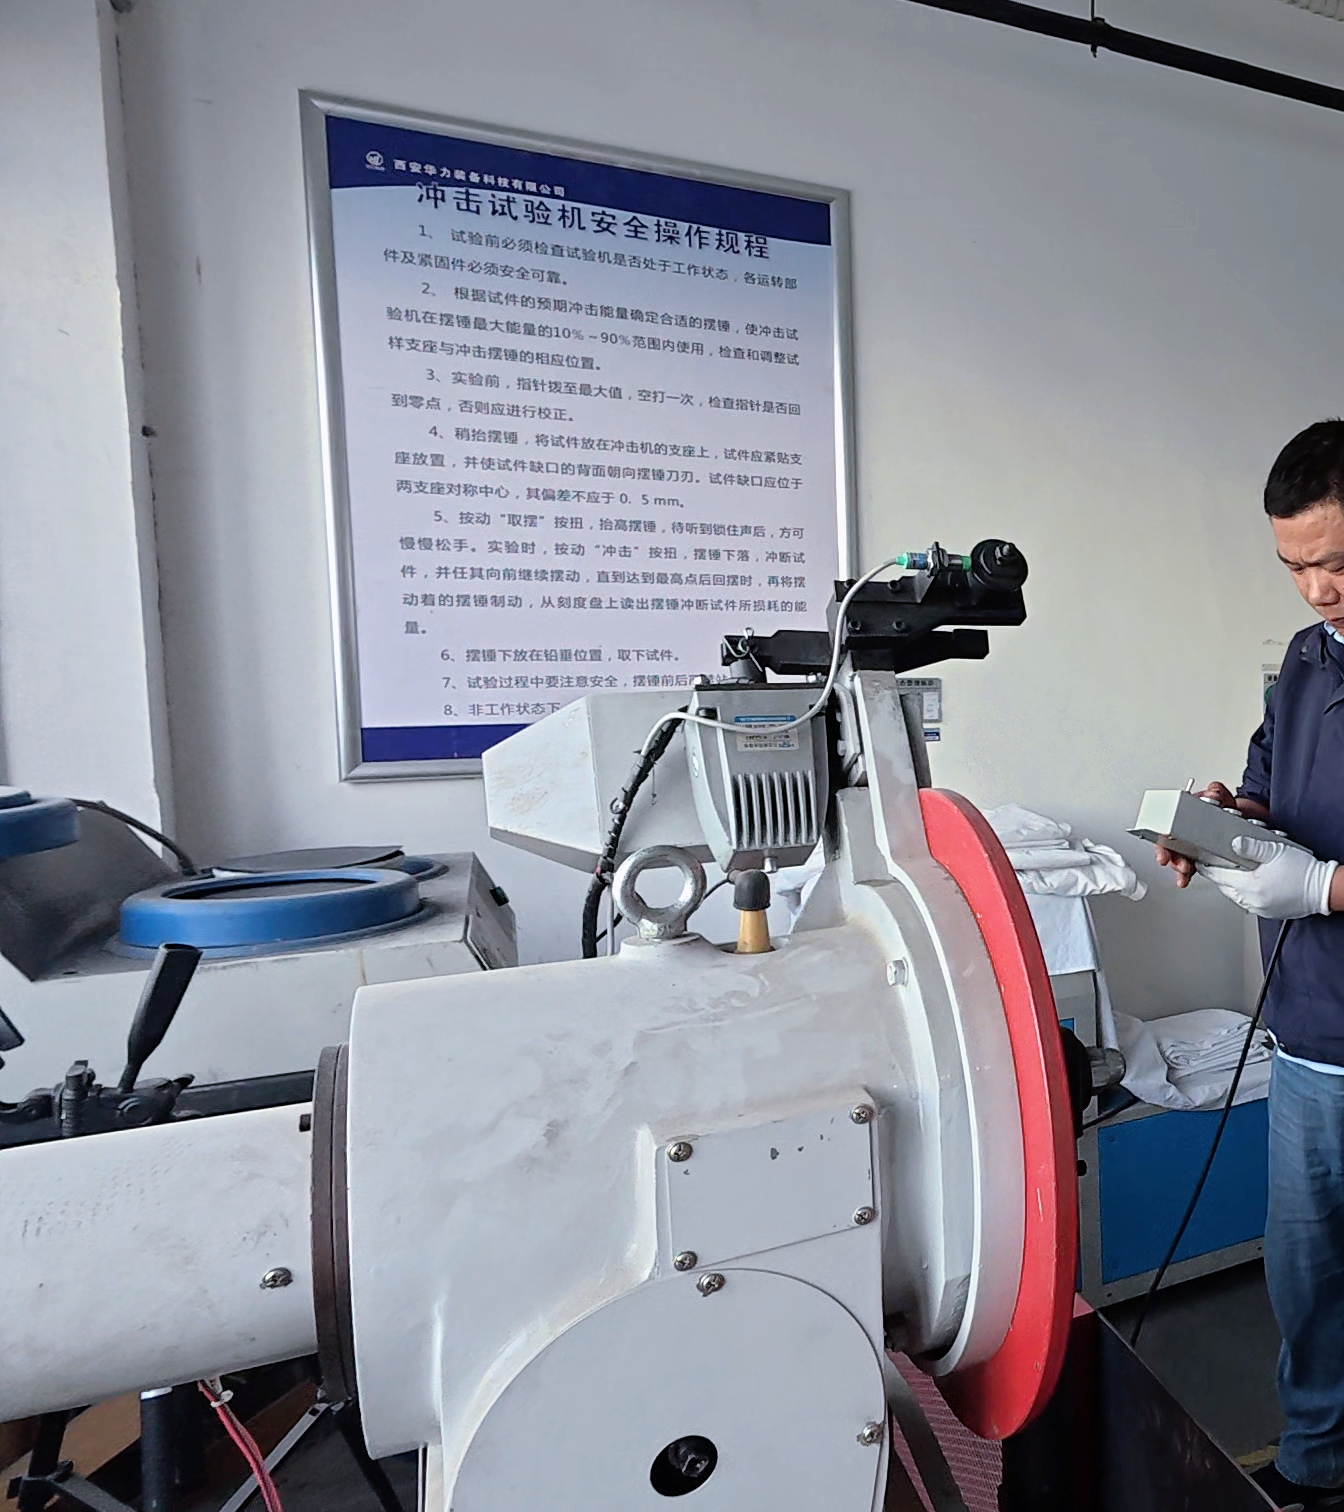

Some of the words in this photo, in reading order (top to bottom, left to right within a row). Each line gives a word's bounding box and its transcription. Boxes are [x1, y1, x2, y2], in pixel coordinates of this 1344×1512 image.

[393, 159, 565, 197] 西安华力装备科技有限公司
[416, 181, 770, 259] 冲击试验机安全操作规程
[383, 247, 568, 286] 件及紧固件必须安全可靠。
[388, 335, 601, 371] 样支座与冲击摆锤的相应位置。
[404, 621, 427, 635] 量。
